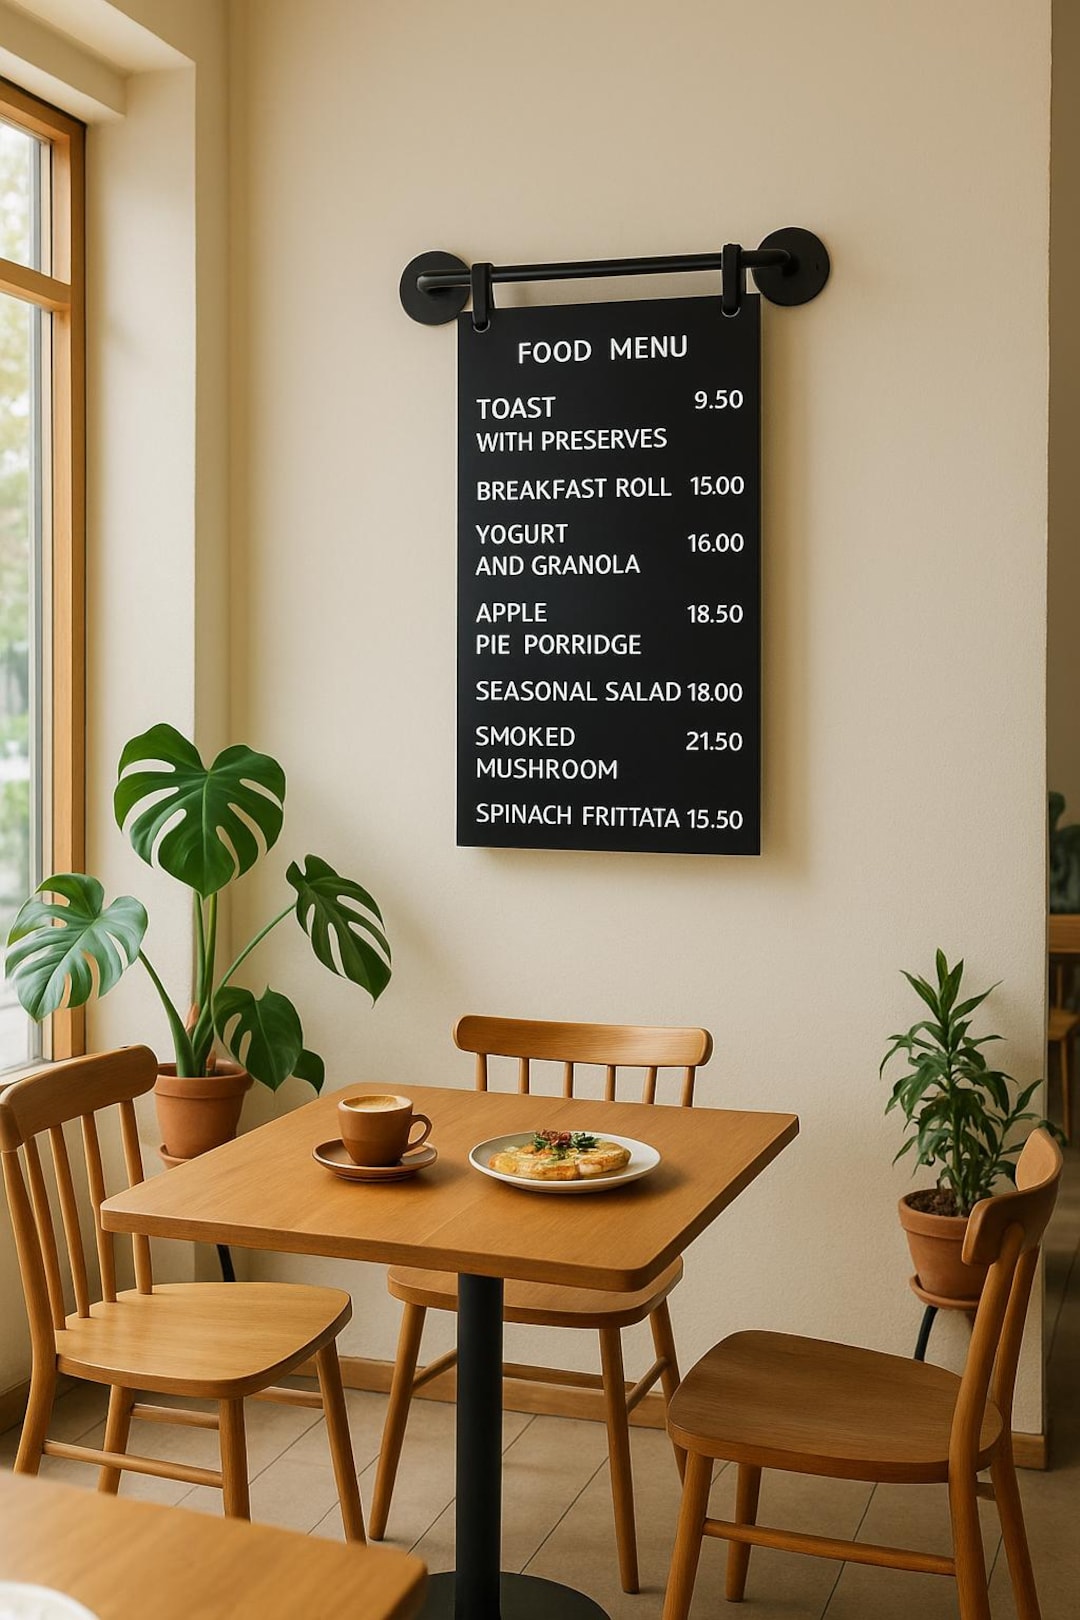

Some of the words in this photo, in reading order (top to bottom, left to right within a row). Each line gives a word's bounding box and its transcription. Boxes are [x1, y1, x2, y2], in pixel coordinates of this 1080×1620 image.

[518, 339, 592, 365] FOOD
[610, 334, 688, 361] MENU
[475, 396, 557, 420] TOAST
[694, 389, 744, 410] 9.50
[475, 431, 533, 453] WITH
[541, 427, 668, 452] PRESERVES
[476, 477, 608, 501] BREAKFAST
[616, 476, 673, 498] ROLL
[689, 475, 745, 496] 15.00
[475, 523, 569, 545] YOGURT
[687, 532, 745, 553] 16.00
[475, 555, 525, 576] AND
[531, 553, 641, 576] GRANOLA
[475, 602, 548, 624] APPLE
[687, 604, 744, 624] 18.50
[476, 634, 511, 655] PIE
[524, 634, 642, 655] PORRIDGE
[475, 680, 598, 702] SEASONAL
[605, 681, 682, 703] SALAD
[687, 682, 744, 703] 18.00
[475, 725, 576, 747] SMOKED
[685, 731, 743, 752] 21.50
[476, 757, 618, 780] MUSHROOM
[476, 802, 572, 825] SPINACH
[582, 805, 681, 829] FRITTATA
[686, 808, 744, 830] 15.50
